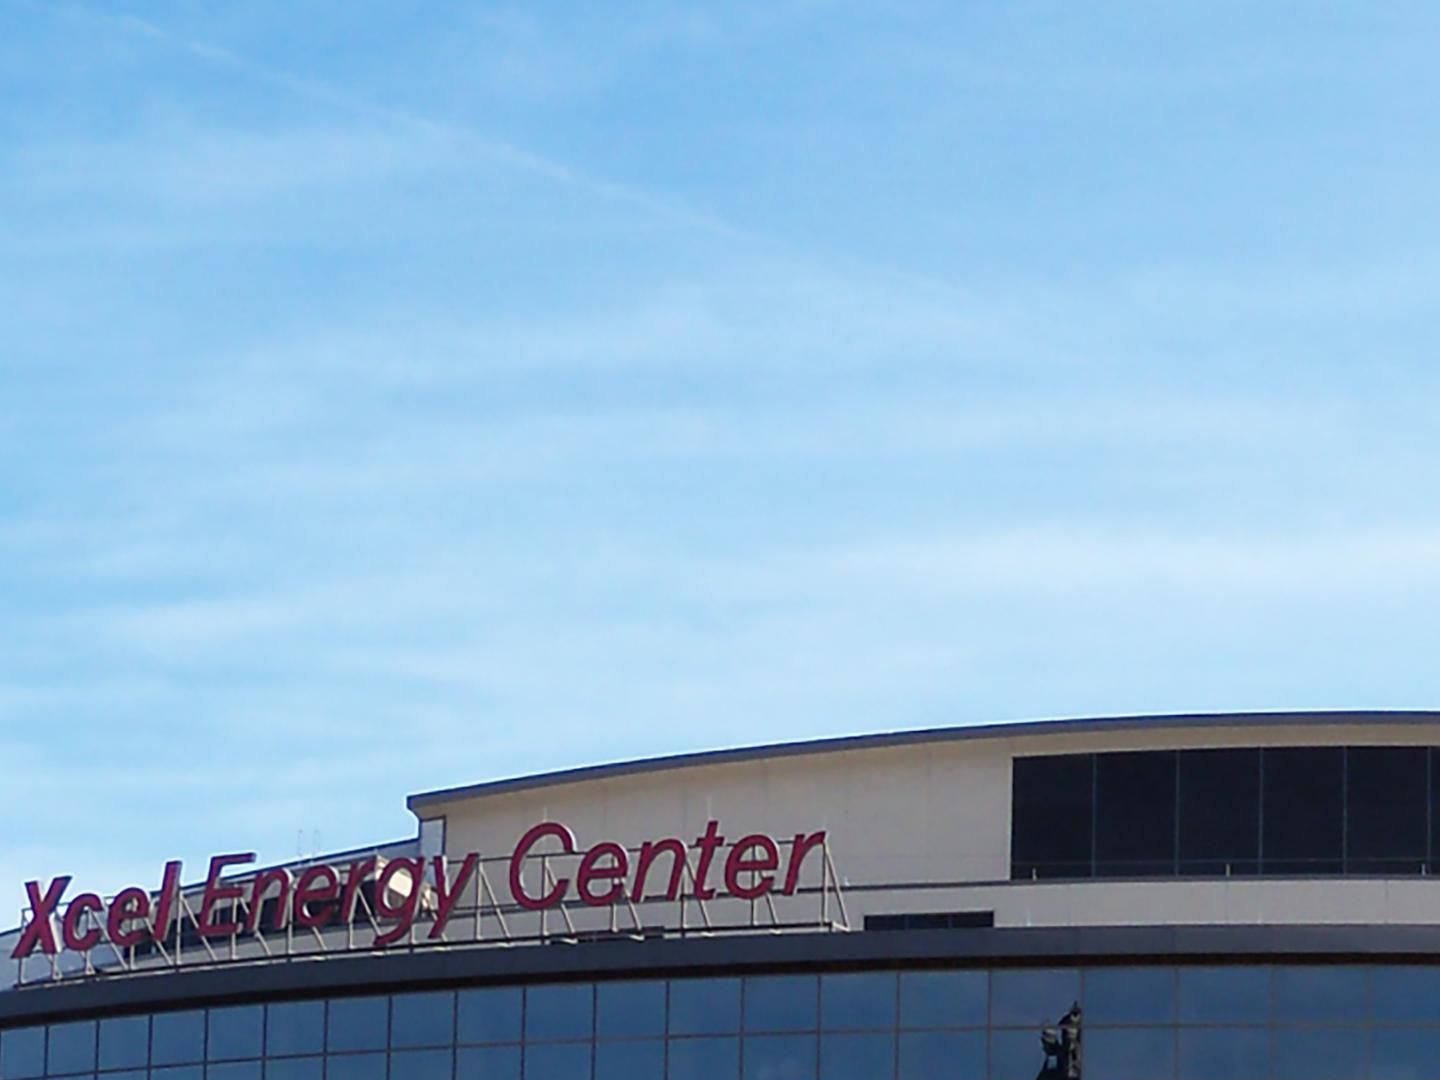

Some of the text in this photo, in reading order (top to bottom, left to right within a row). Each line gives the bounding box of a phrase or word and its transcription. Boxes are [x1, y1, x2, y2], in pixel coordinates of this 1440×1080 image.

[11, 820, 827, 959] Xcel Energy Center
